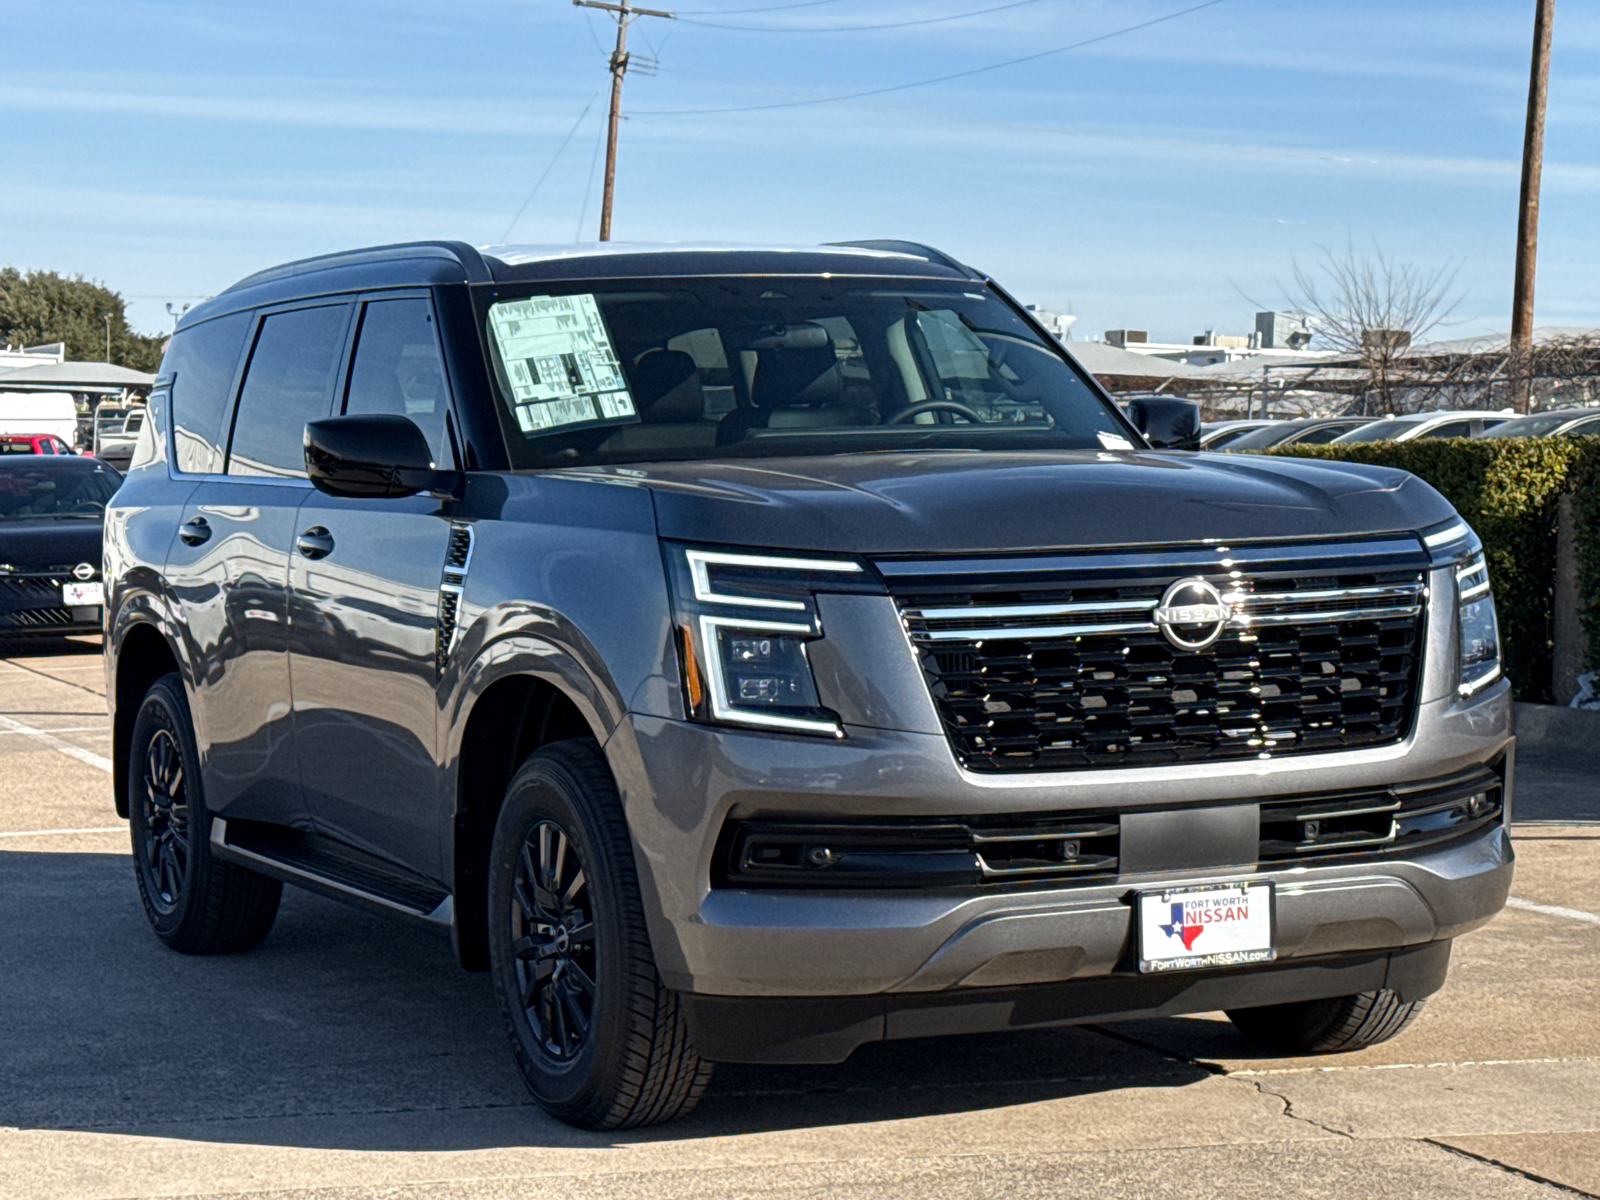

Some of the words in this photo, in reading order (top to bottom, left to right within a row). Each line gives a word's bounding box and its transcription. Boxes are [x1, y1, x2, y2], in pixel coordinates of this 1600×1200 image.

[1155, 607, 1231, 622] NISSAN
[1184, 900, 1210, 910] FORT
[1212, 896, 1249, 907] WORTH
[1185, 906, 1249, 925] NISSAN
